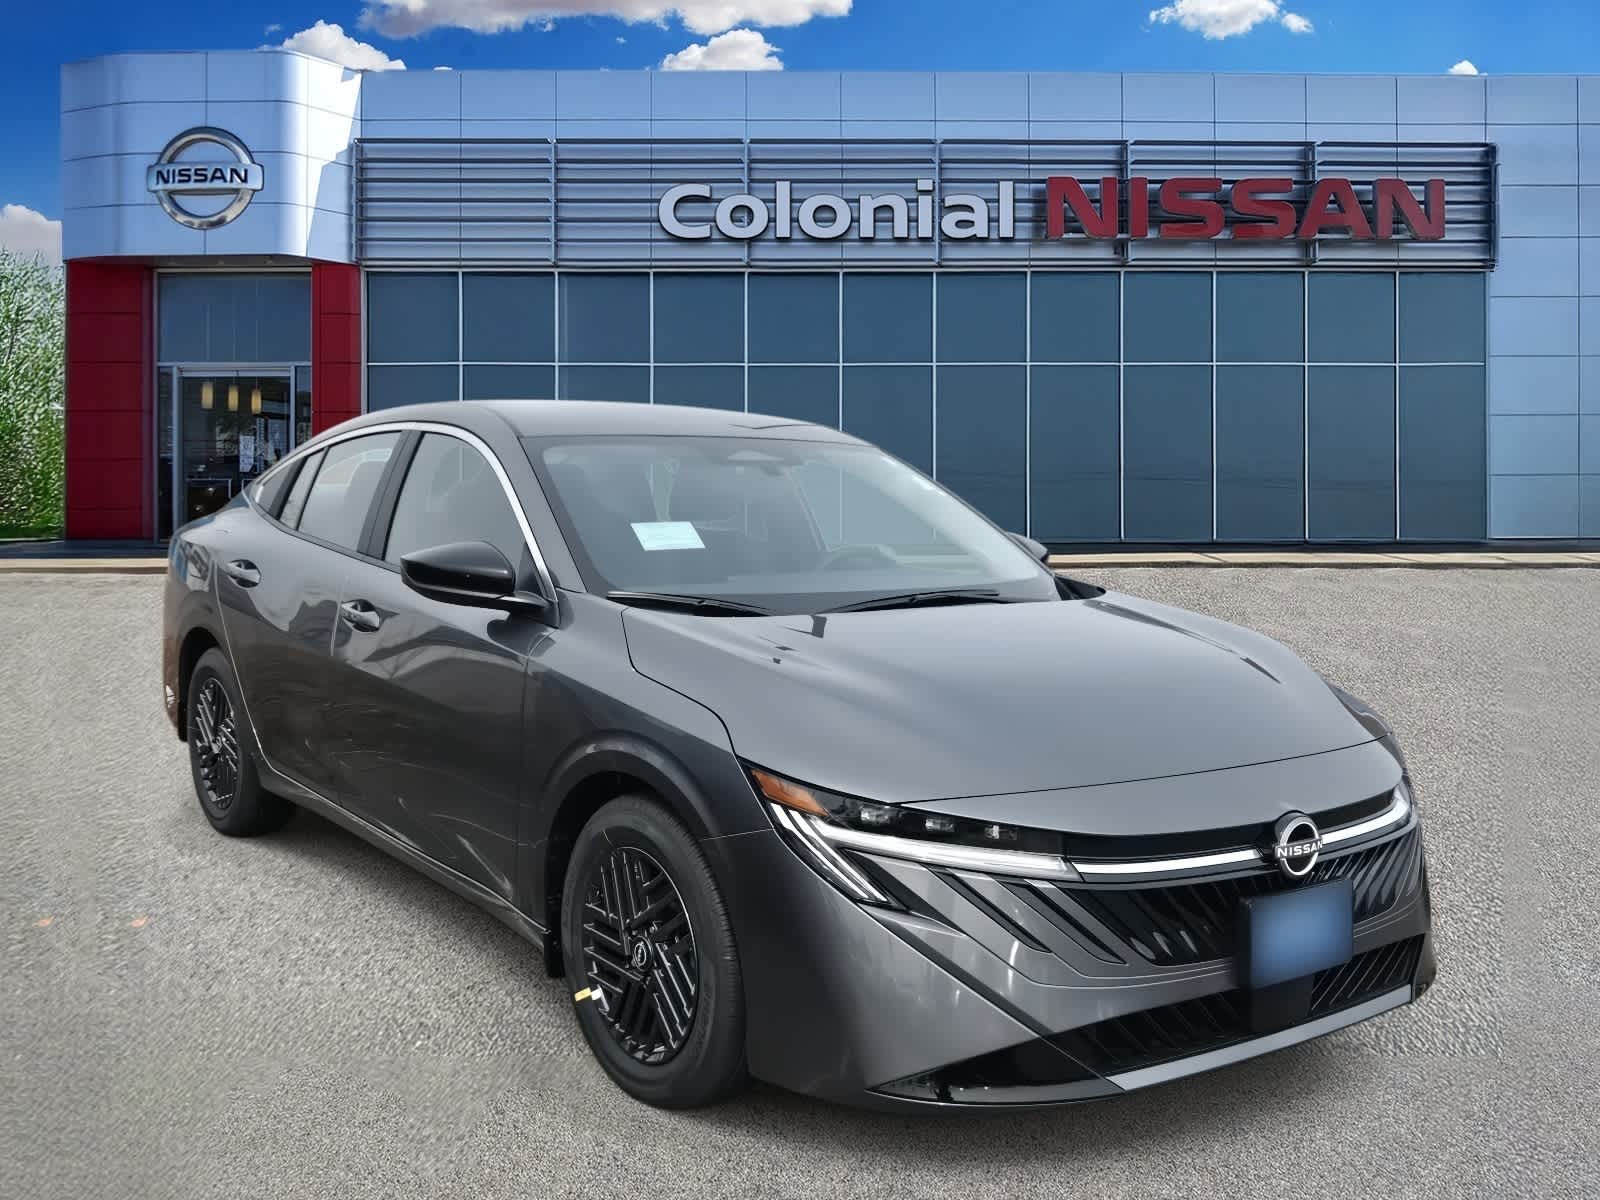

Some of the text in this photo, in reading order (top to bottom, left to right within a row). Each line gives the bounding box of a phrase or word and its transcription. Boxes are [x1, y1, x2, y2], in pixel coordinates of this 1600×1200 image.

[156, 167, 248, 184] NISSAN
[658, 176, 1445, 240] Colonial NISSAN
[1277, 842, 1323, 857] NISSAN
